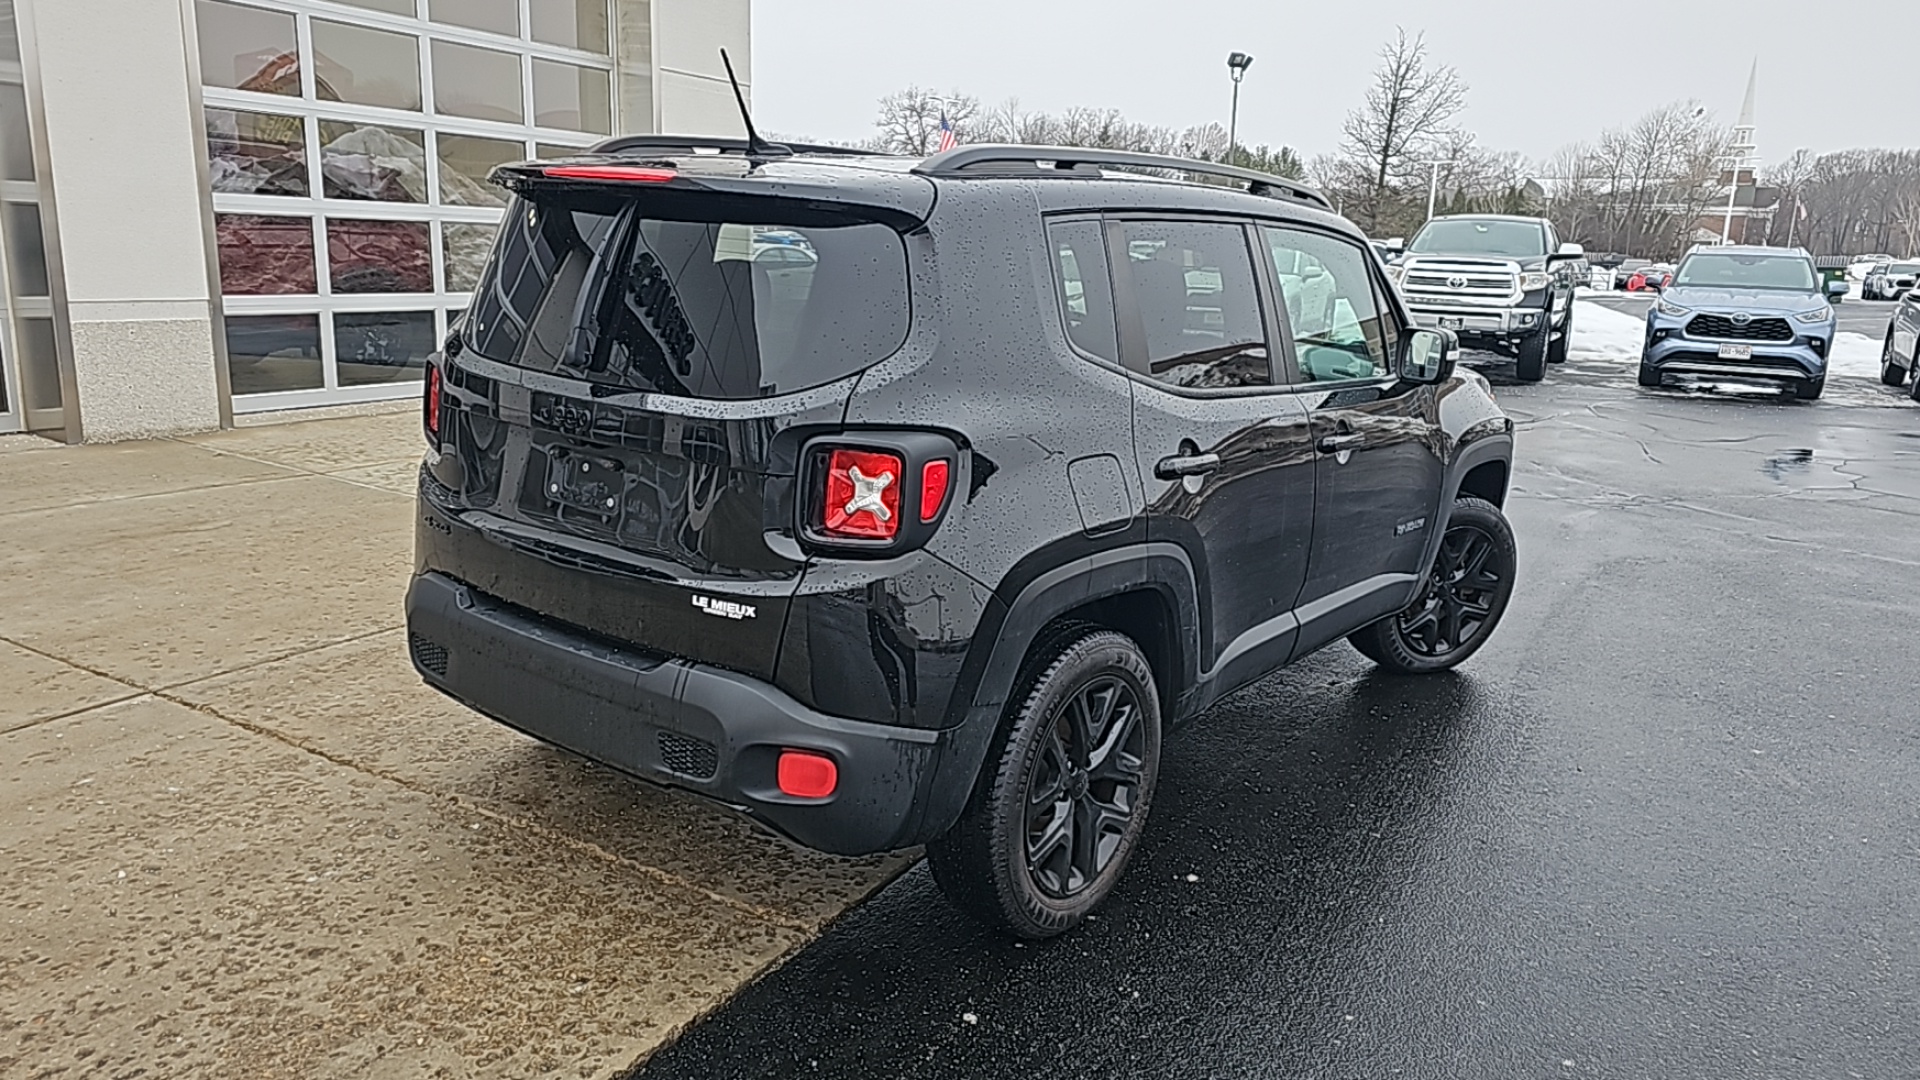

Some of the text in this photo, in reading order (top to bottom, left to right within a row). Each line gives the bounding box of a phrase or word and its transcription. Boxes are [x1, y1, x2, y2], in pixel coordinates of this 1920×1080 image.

[539, 402, 592, 434] Jeep
[692, 594, 757, 618] LE MIEUX
